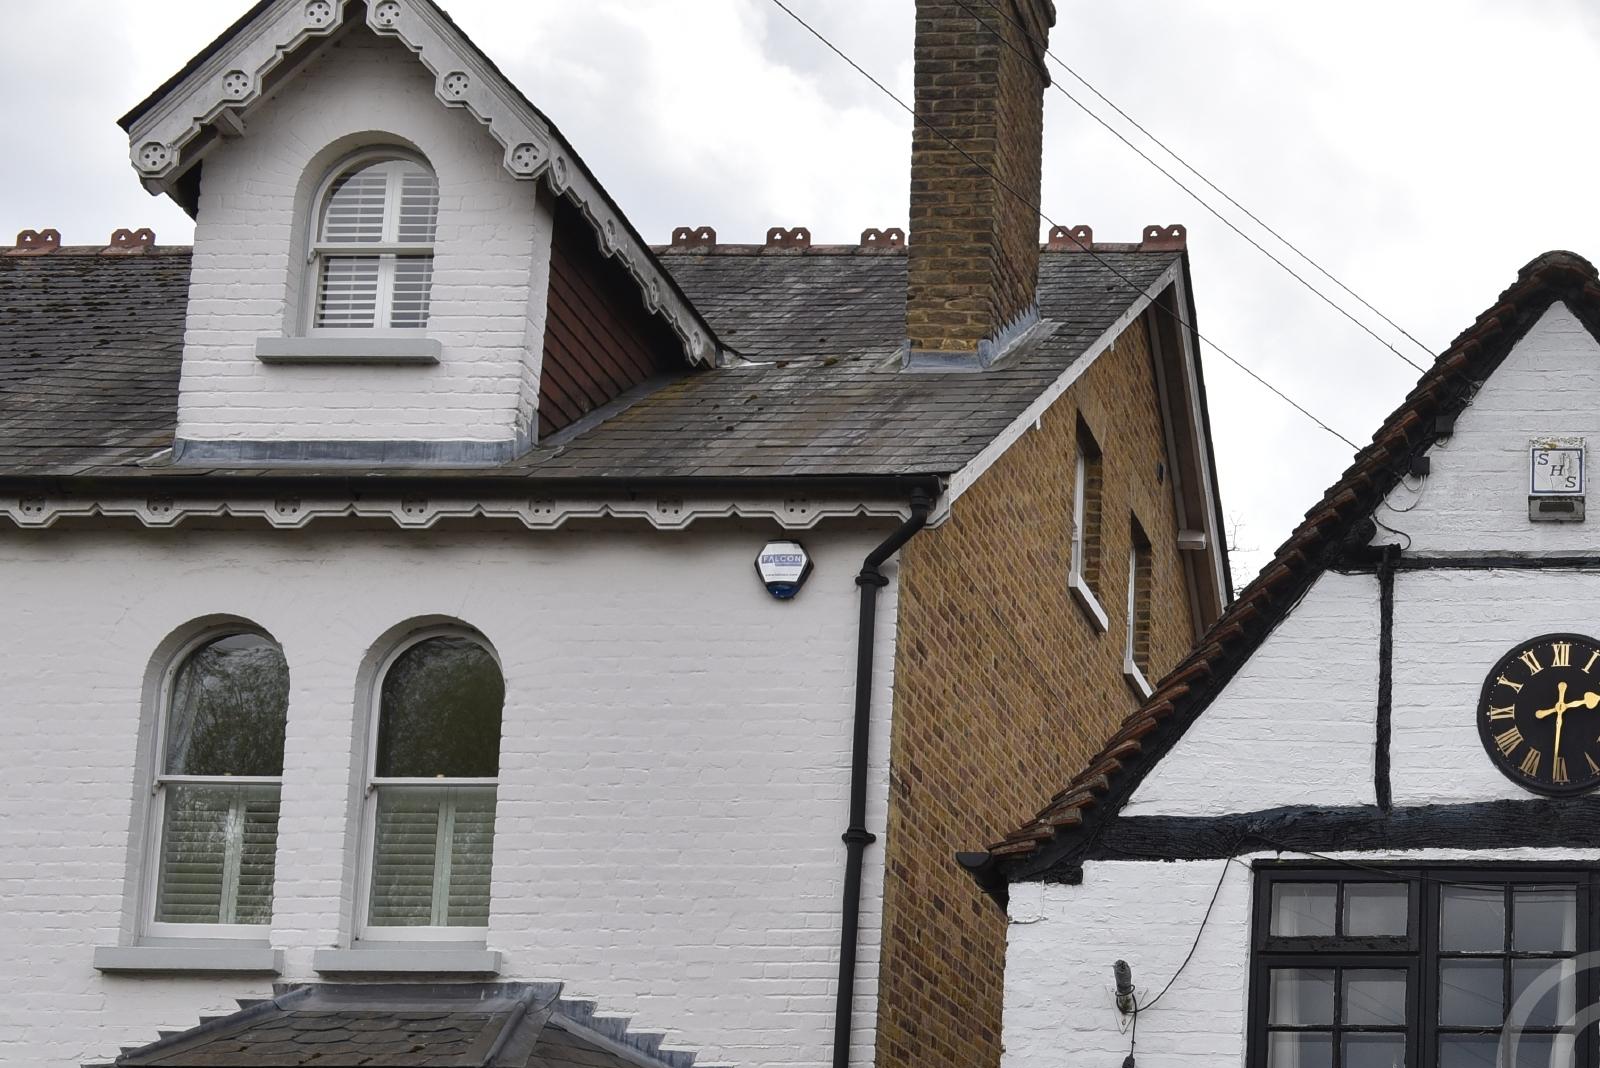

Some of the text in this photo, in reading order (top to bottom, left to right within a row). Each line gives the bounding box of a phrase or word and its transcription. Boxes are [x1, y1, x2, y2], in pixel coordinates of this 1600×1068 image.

[1518, 649, 1544, 676] XI
[1551, 643, 1571, 667] XII
[1581, 650, 1600, 674] I
[1498, 674, 1524, 694] X
[1490, 703, 1515, 721] IX
[1494, 725, 1524, 757] VIII
[1519, 747, 1541, 777] VII
[1584, 751, 1600, 775] V
